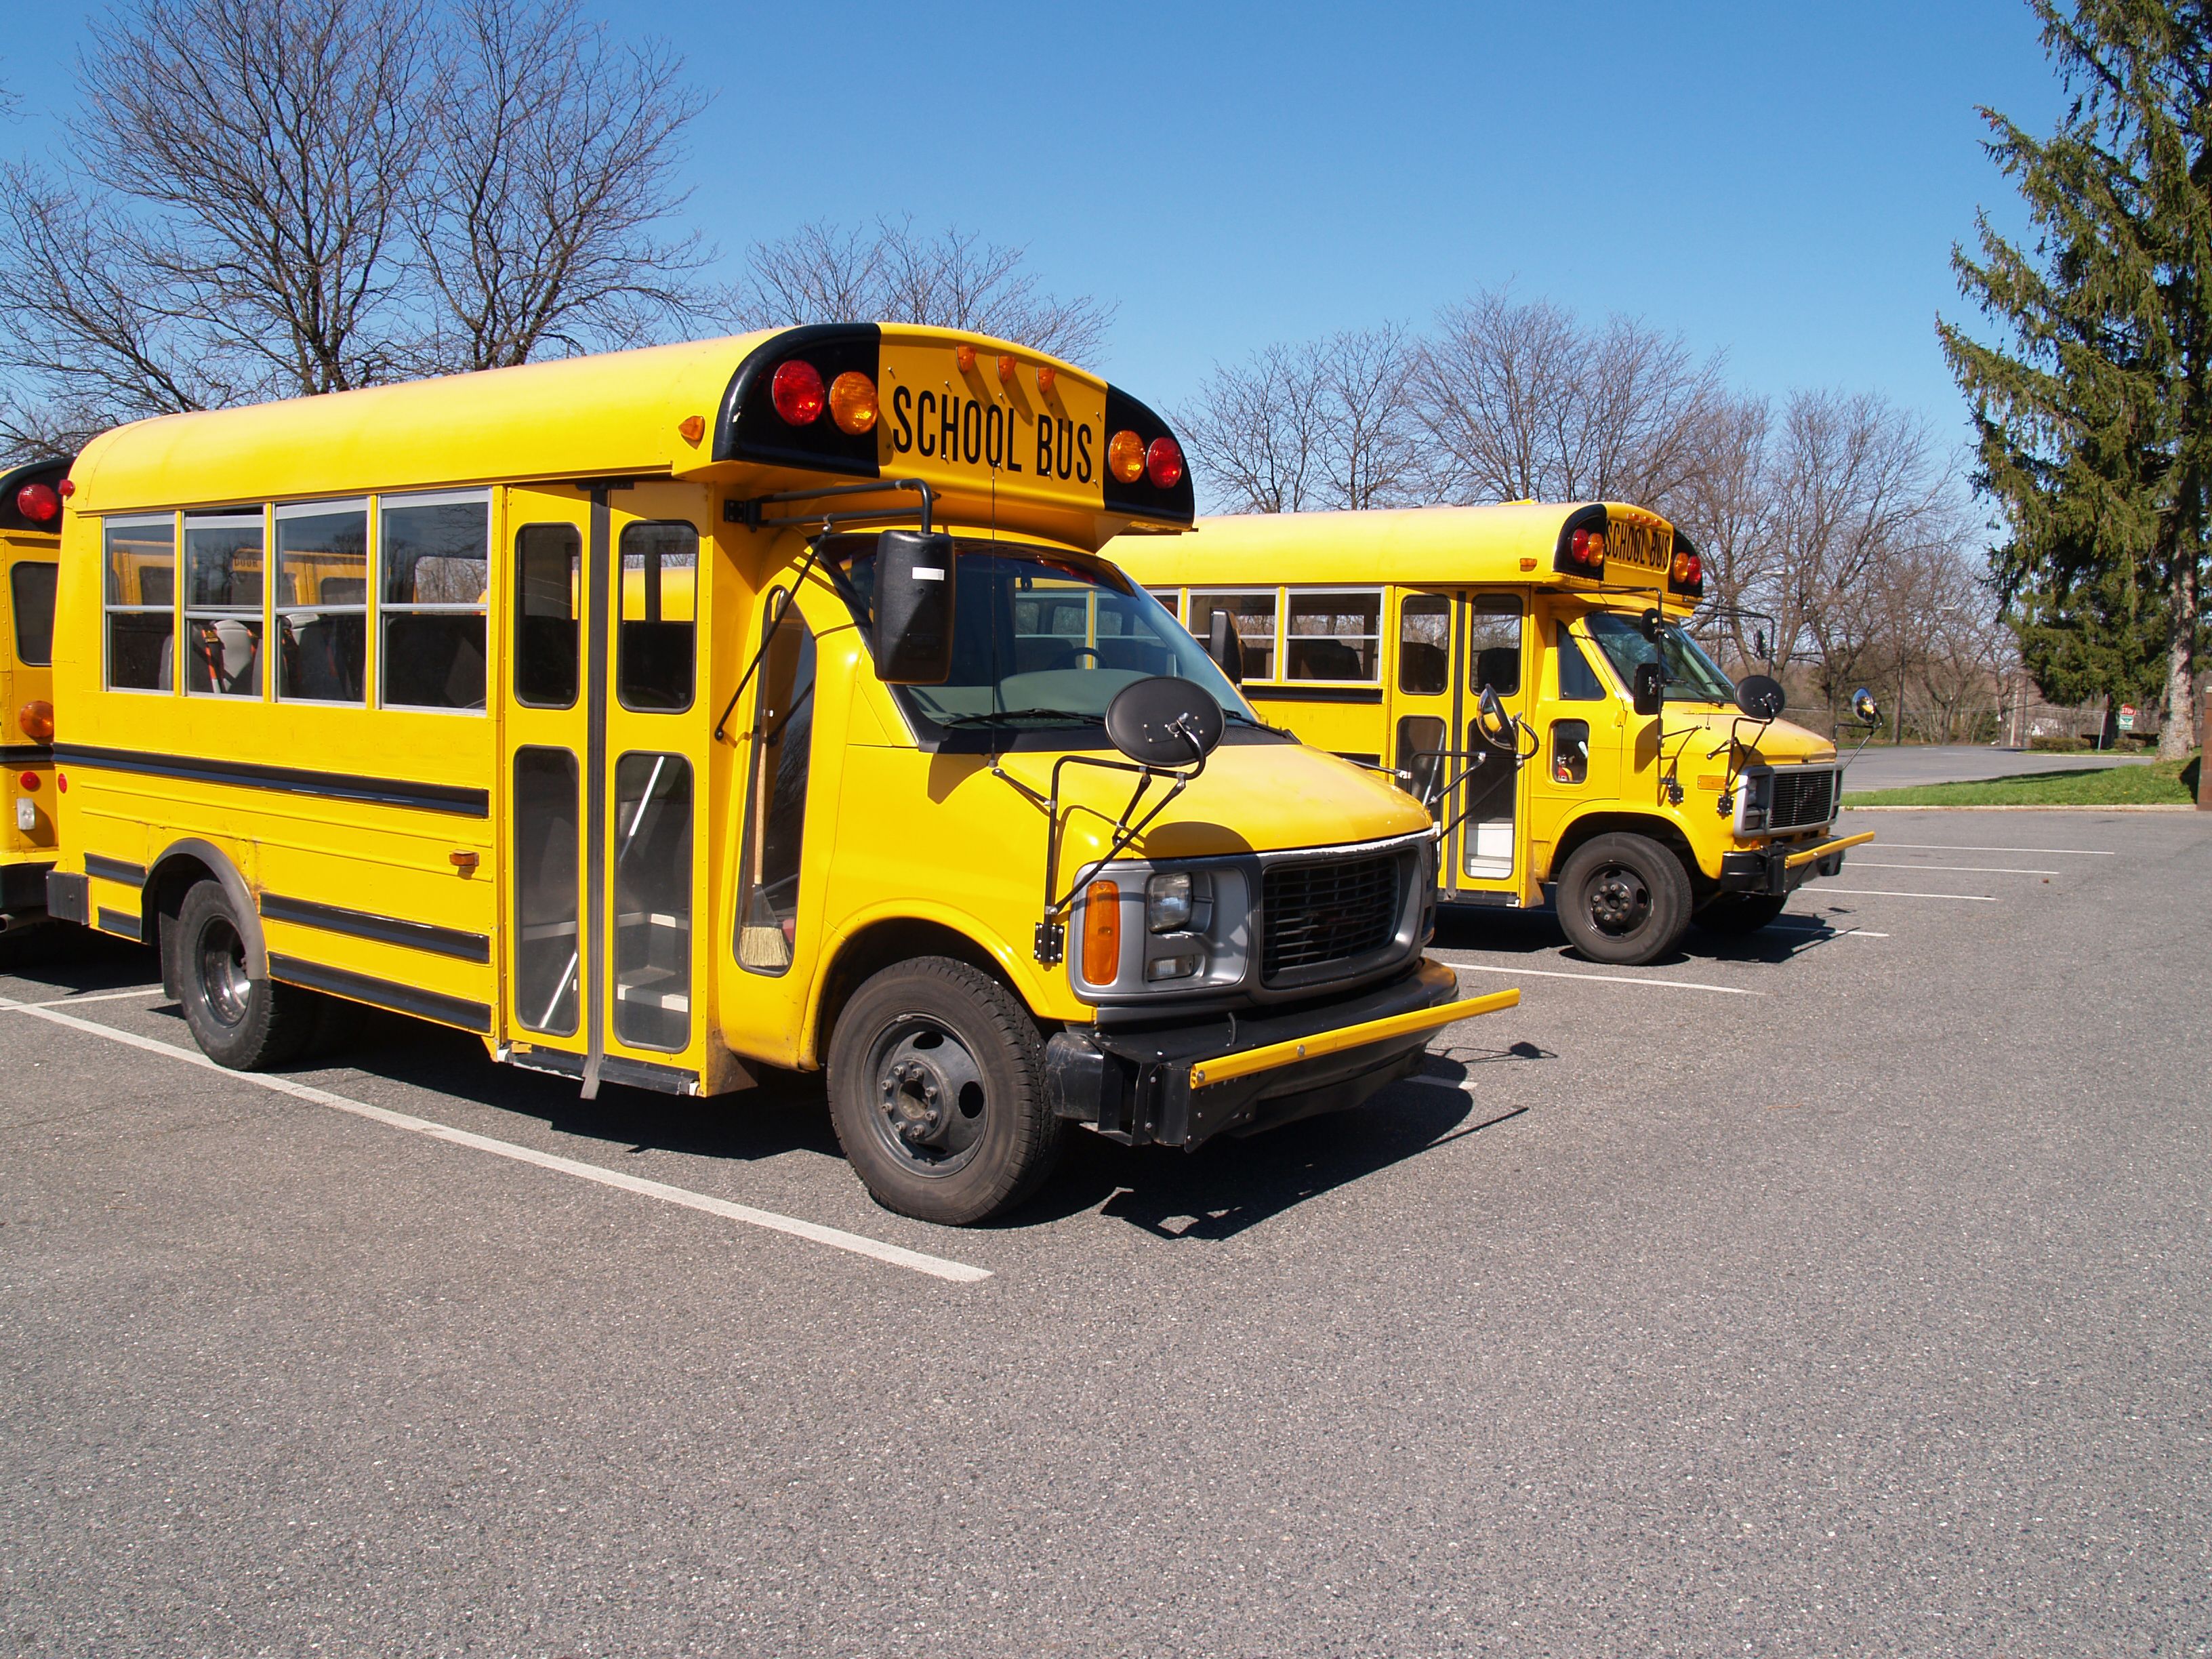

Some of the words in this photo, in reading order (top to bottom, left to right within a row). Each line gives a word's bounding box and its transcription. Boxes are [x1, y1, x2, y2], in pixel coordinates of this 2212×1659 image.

[893, 385, 1022, 472] SCHOOL
[1036, 413, 1092, 484] BUS
[1605, 520, 1645, 564] SCHOOL
[1650, 531, 1671, 569] BUS
